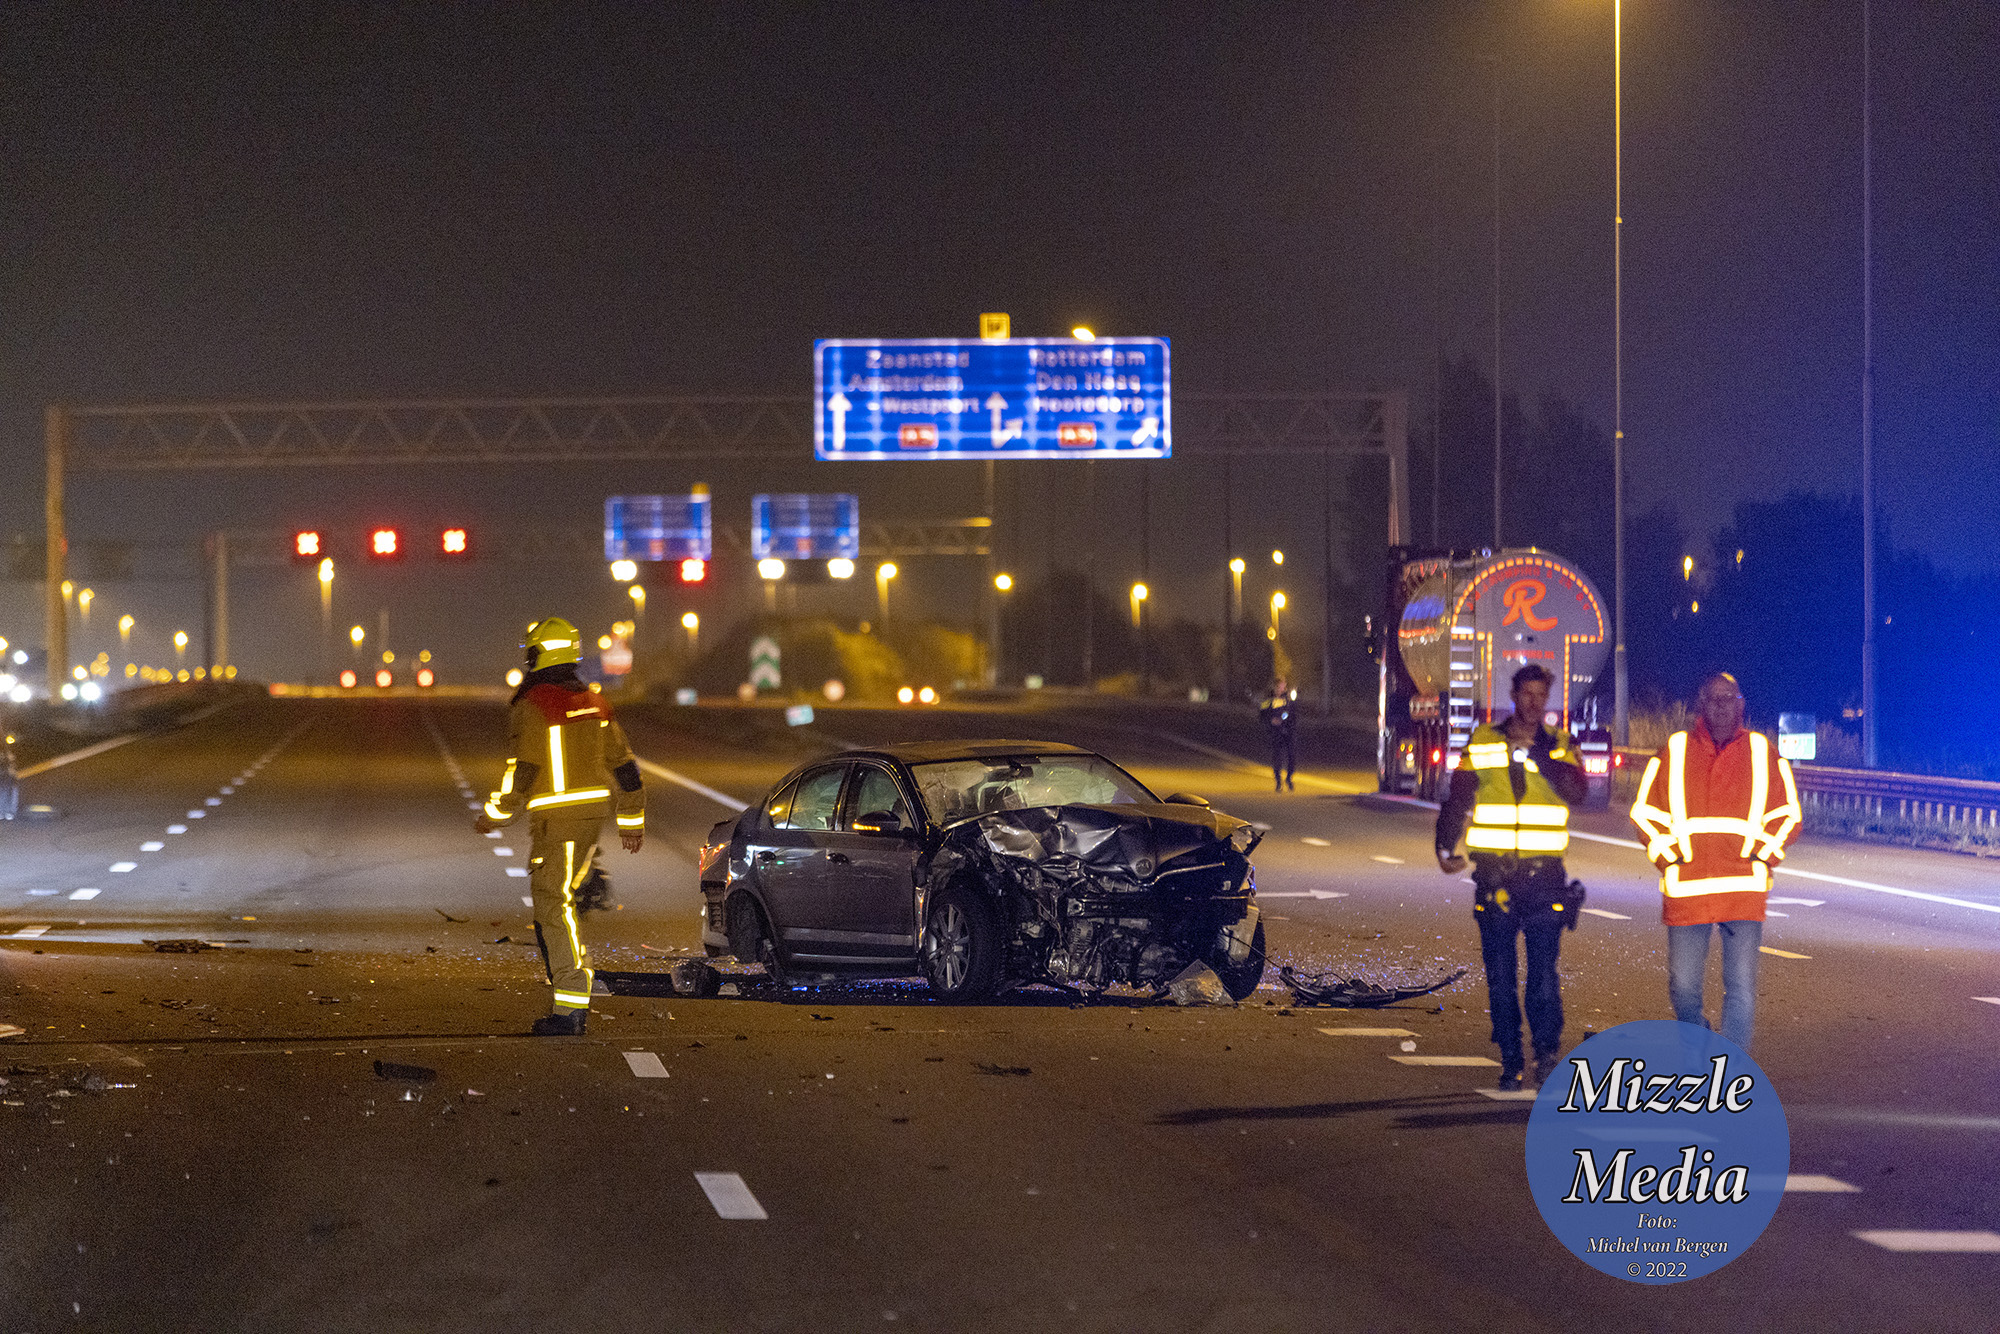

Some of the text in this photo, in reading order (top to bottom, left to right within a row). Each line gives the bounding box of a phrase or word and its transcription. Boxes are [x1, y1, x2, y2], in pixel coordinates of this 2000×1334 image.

[866, 350, 970, 368] Zaanstad
[1029, 348, 1146, 367] Rotterdam
[848, 374, 964, 391] Amsterdam
[1036, 371, 1141, 394] Den Haag
[1503, 579, 1558, 631] R
